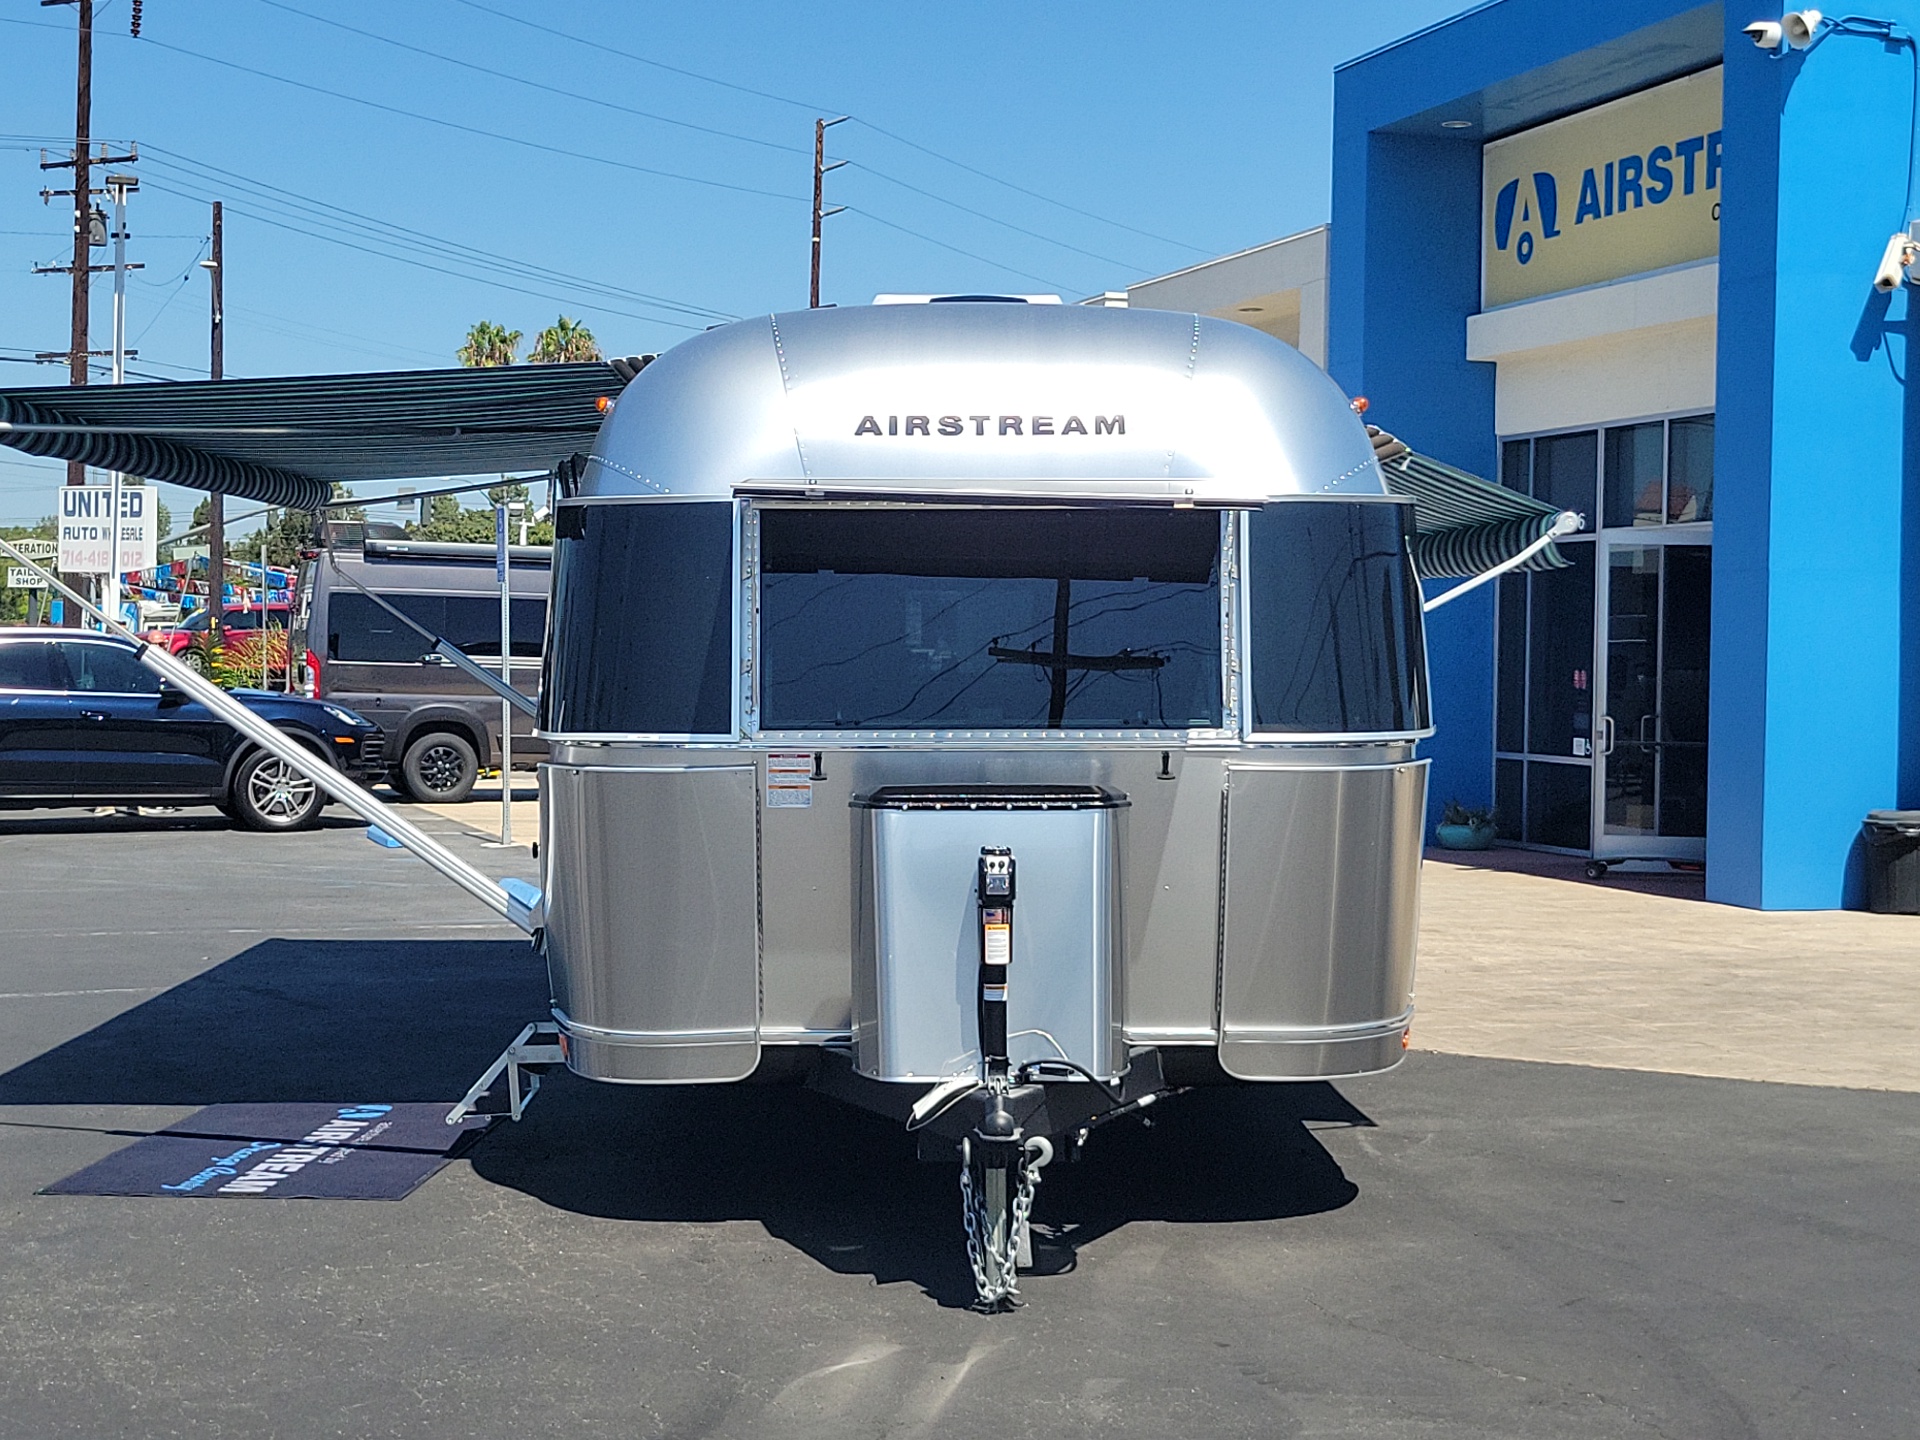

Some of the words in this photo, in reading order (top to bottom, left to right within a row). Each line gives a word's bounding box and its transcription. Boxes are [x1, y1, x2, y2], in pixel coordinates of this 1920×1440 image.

[854, 415, 1126, 436] AIRSTREAM
[63, 491, 143, 518] UNITED
[63, 526, 98, 540] AUTO
[10, 568, 49, 577] TAIL
[15, 577, 43, 586] SHOP
